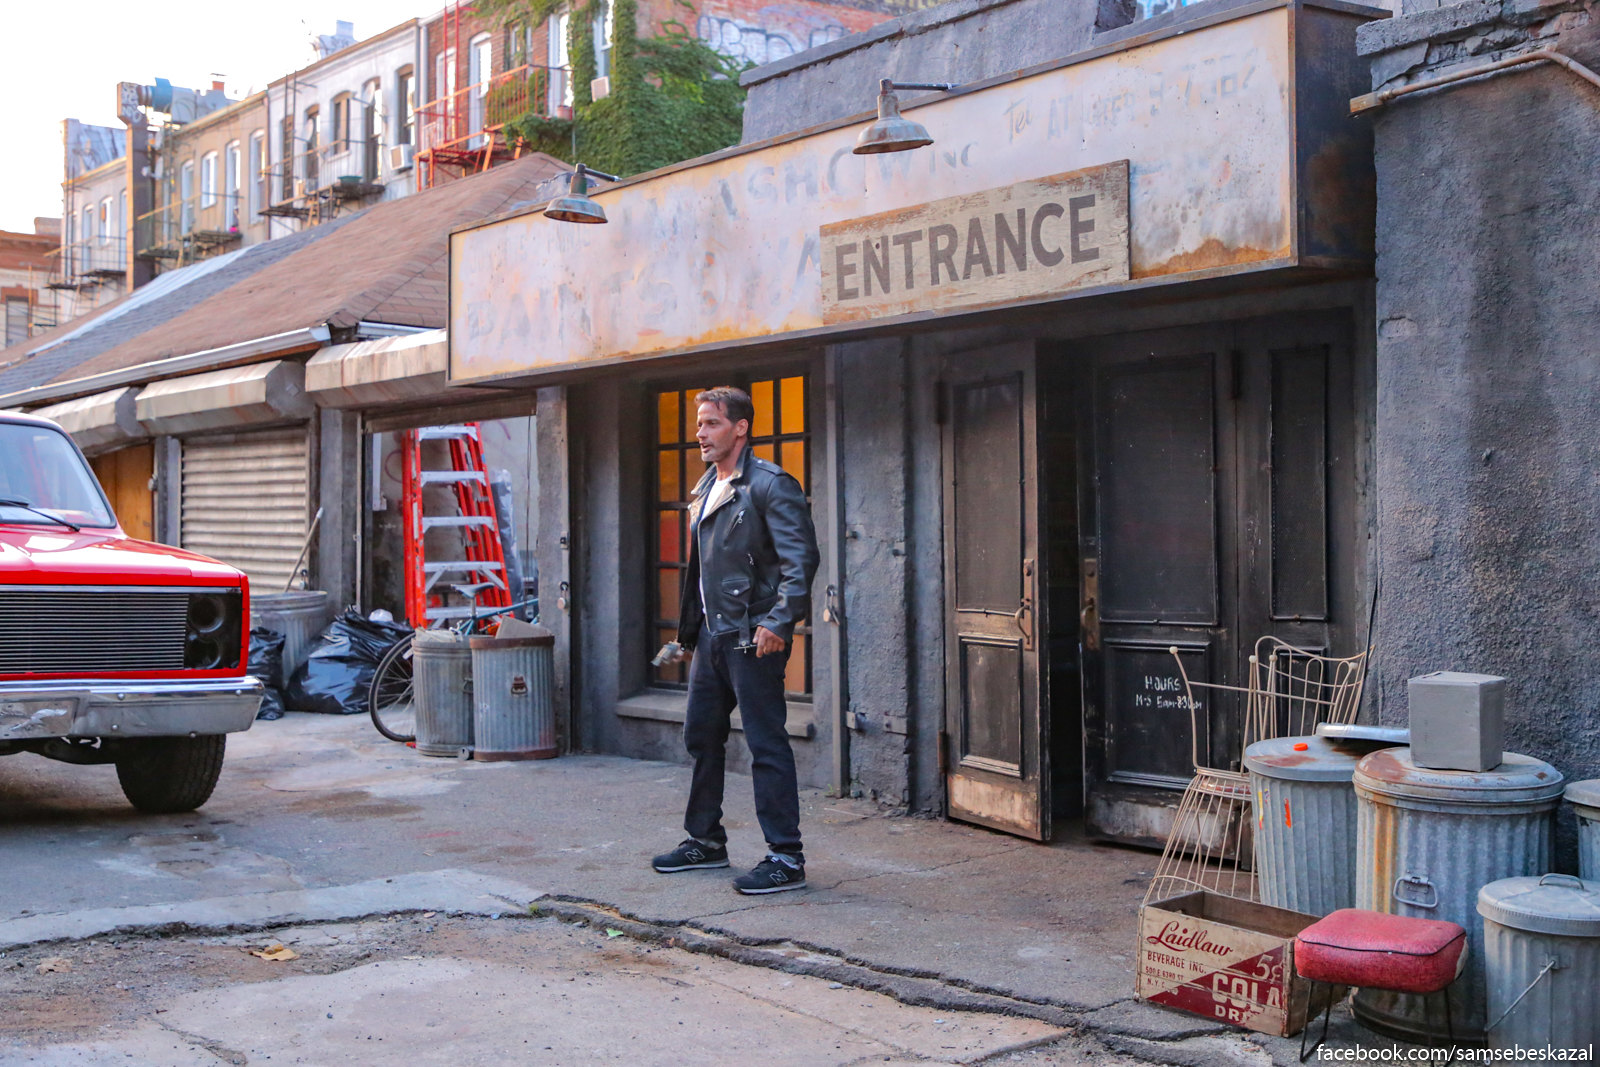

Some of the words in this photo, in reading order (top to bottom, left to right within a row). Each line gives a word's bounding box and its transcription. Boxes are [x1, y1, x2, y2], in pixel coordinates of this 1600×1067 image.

[835, 194, 1100, 302] ENTRANCE
[1145, 676, 1181, 691] HOURS
[1147, 920, 1233, 957] Laidlaw
[1147, 951, 1185, 969] BEVERAGE
[1212, 972, 1281, 1013] COLA
